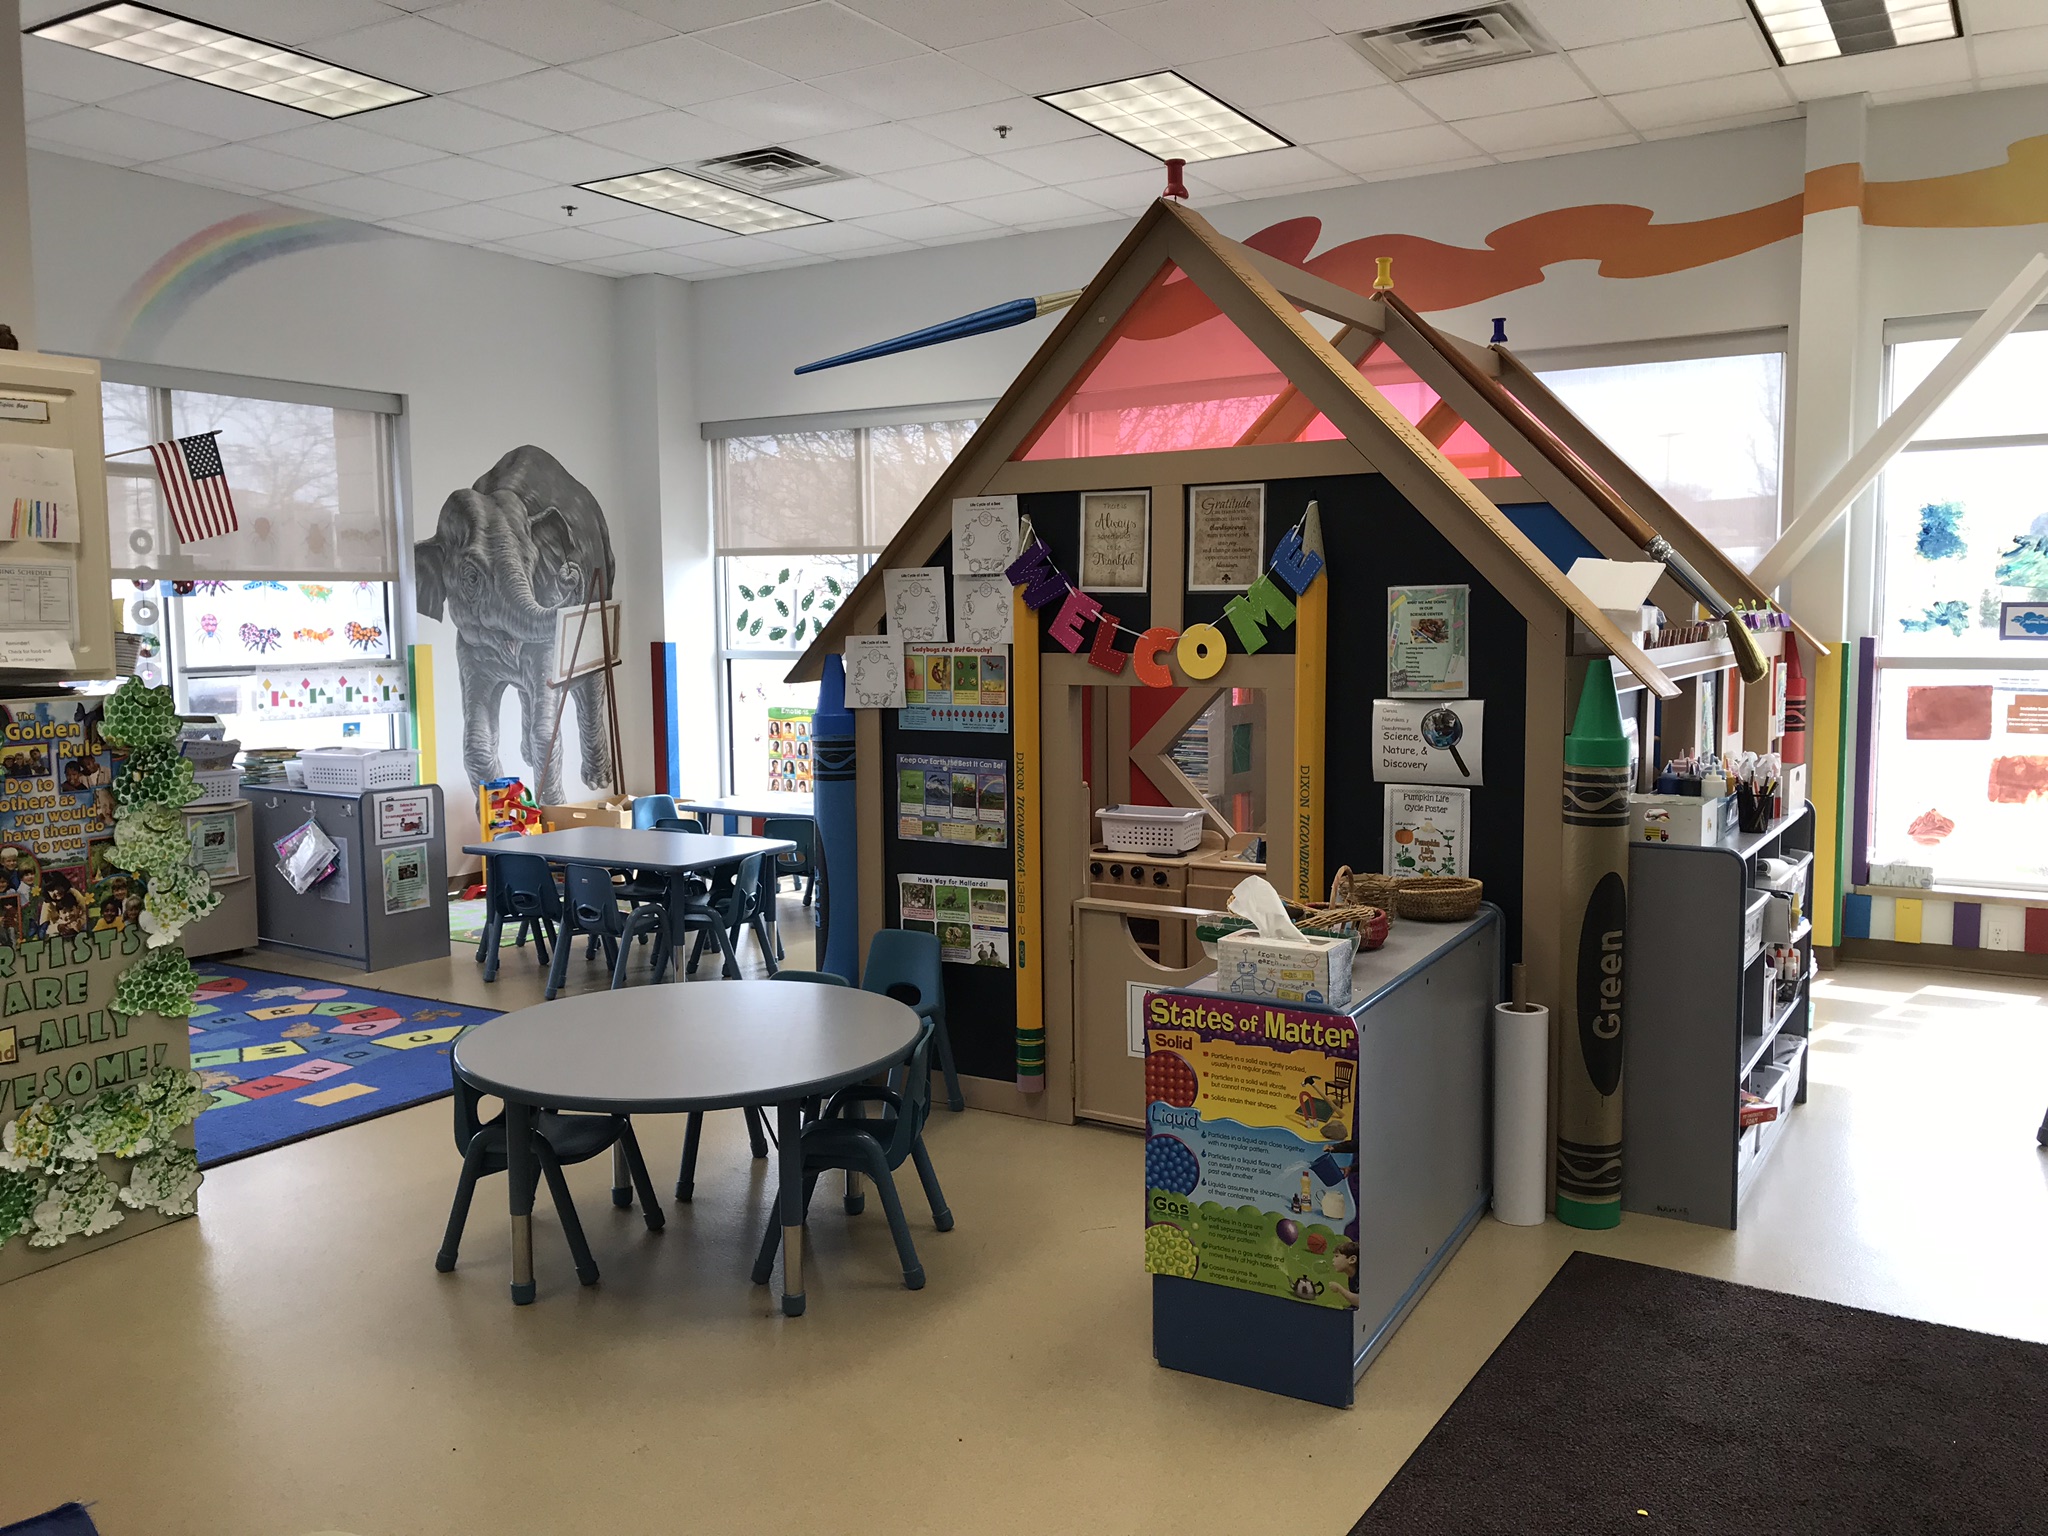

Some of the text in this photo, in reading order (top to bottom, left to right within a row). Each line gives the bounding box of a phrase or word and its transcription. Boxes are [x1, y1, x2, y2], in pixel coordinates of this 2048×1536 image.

[1202, 496, 1251, 515] Gratitude
[1095, 512, 1136, 534] Always
[1093, 552, 1135, 570] Thankful
[1004, 528, 1324, 688] WELCOME
[16, 712, 35, 721] The
[5, 721, 80, 741] Golden
[1383, 732, 1421, 742] Science,
[58, 740, 102, 759] Rule
[1383, 745, 1427, 756] Nature, &
[1383, 759, 1428, 771] Discovery
[4, 778, 54, 795] Do to
[0, 795, 76, 812] others as
[1403, 793, 1449, 803] Pumpkin Life
[15, 804, 98, 827] you would
[1016, 751, 1025, 873] DIXON TICONDEROGA
[1404, 804, 1448, 813] Cycle Poster
[2, 821, 105, 843] have them do
[1299, 765, 1310, 899] DIXON TICONDEROGA
[33, 837, 86, 854] to you.
[1414, 838, 1440, 849] Pumpkin
[1421, 847, 1434, 855] Life
[1418, 853, 1436, 863] Cycle
[0, 923, 141, 979] RTISTS
[1593, 930, 1623, 1039] Green
[3, 970, 88, 1018] ARE
[270, 1007, 295, 1016] R
[1150, 997, 1355, 1048] States of Matter
[408, 1034, 433, 1043] C
[1155, 1033, 1193, 1050] Solid
[343, 1050, 368, 1060] D
[1211, 1052, 1233, 1061] Particles
[1269, 1061, 1284, 1070] tightly
[1285, 1065, 1307, 1073] packed,
[300, 1066, 330, 1075] E
[1211, 1061, 1230, 1069] usually
[1242, 1065, 1260, 1073] regular
[0, 1043, 168, 1114] ESOME!
[252, 1081, 284, 1092] F
[1211, 1073, 1233, 1081] Particles
[1269, 1082, 1286, 1090] vibrate
[1211, 1094, 1226, 1102] Solids
[1221, 1082, 1239, 1090] cannot
[1269, 1090, 1282, 1098] each
[1151, 1105, 1199, 1131] Liquid
[1207, 1132, 1230, 1140] Particles
[1242, 1136, 1257, 1145] liquid
[1283, 1144, 1305, 1153] together
[1208, 1139, 1219, 1147] with
[1229, 1143, 1248, 1151] regular
[1207, 1152, 1230, 1160] Particles
[1242, 1157, 1257, 1165] liquid
[1220, 1162, 1234, 1170] easily
[1208, 1181, 1226, 1189] Liquids
[1227, 1184, 1249, 1192] assume
[1260, 1190, 1280, 1198] shapes
[1153, 1196, 1189, 1215] Gas
[1209, 1216, 1230, 1225] Particles
[1209, 1244, 1230, 1253] Particles
[1254, 1252, 1272, 1260] vibrate
[1225, 1254, 1239, 1262] freely
[1247, 1258, 1258, 1266] high
